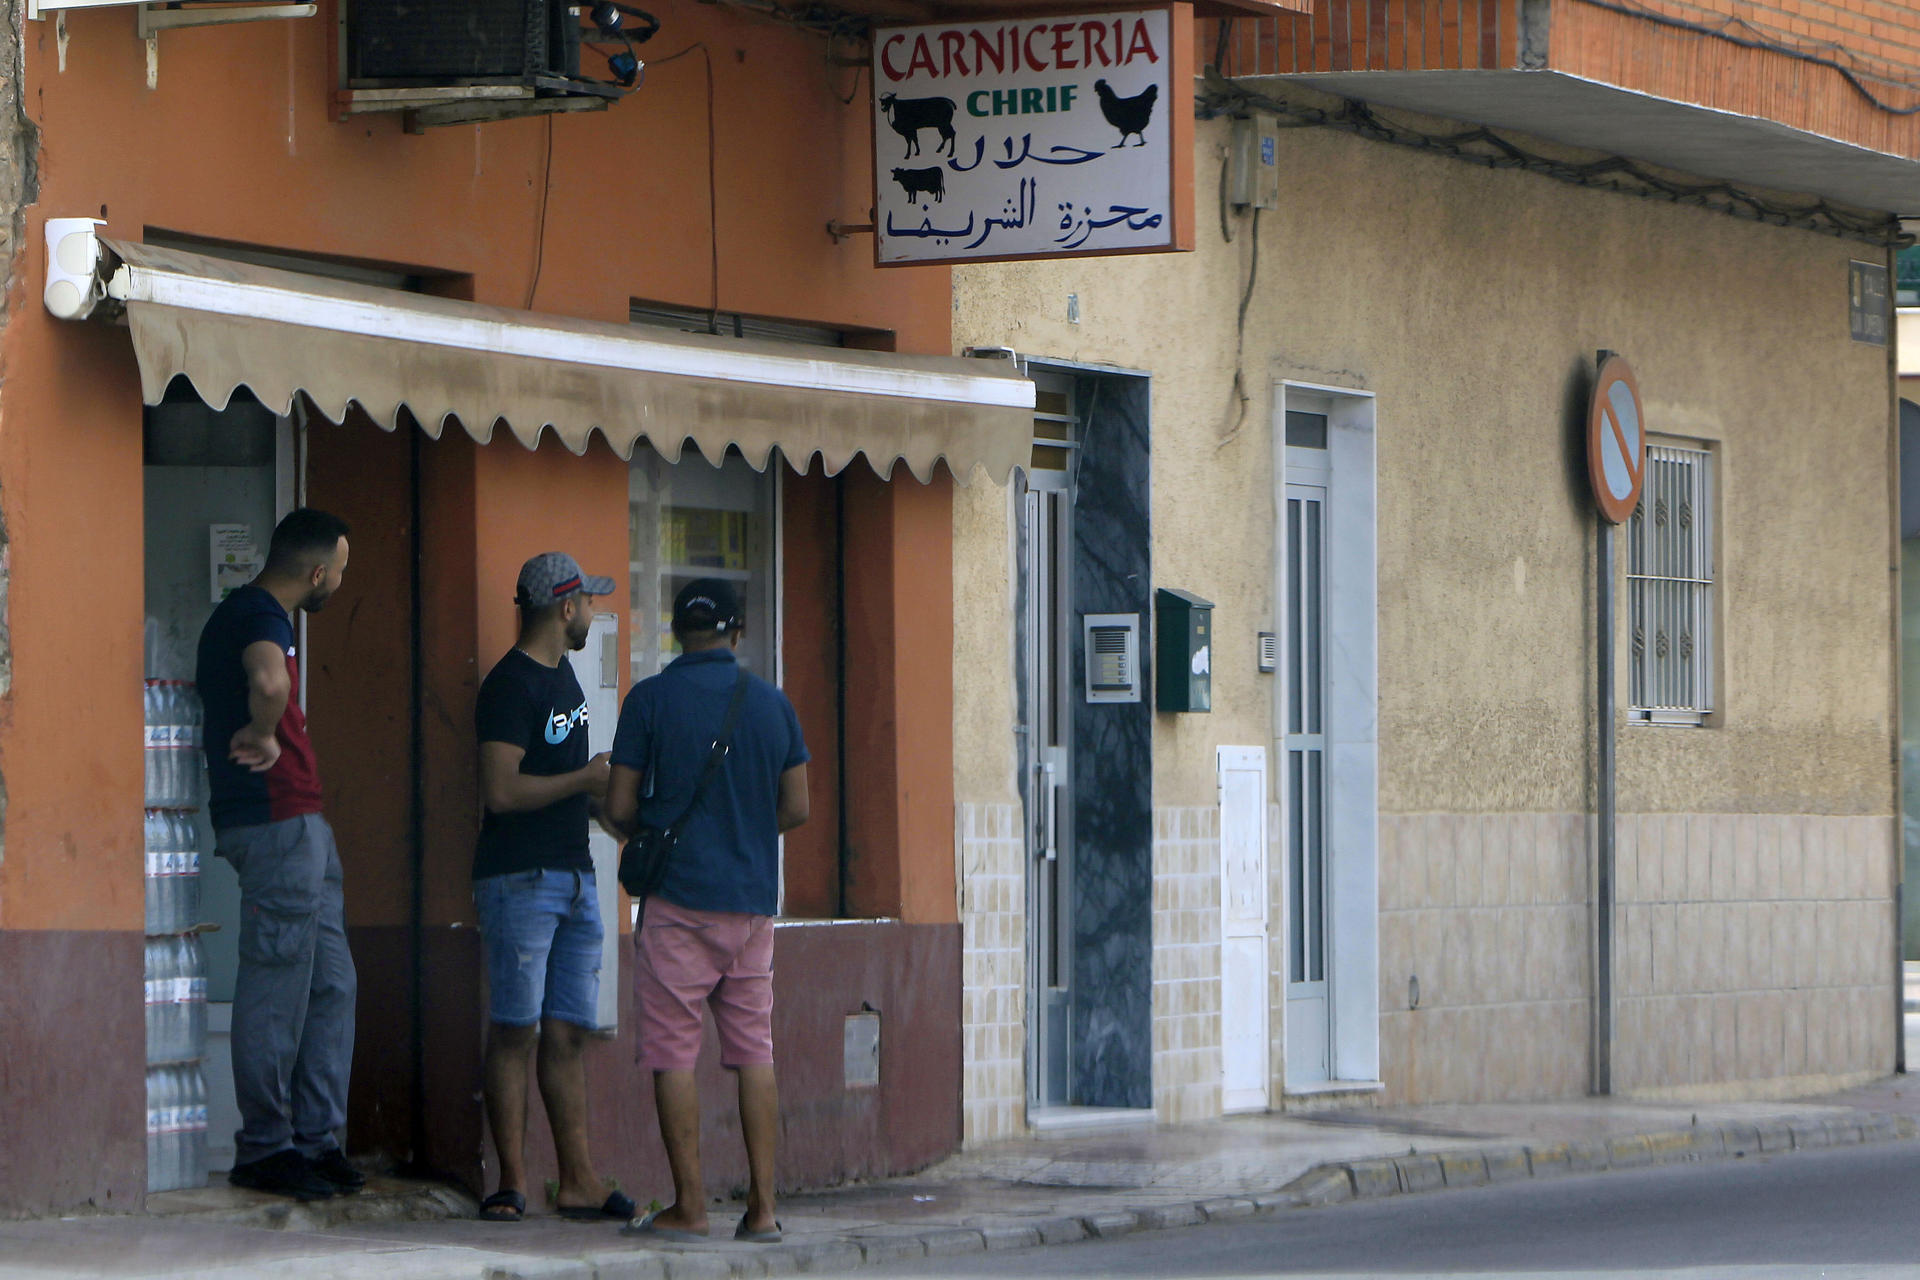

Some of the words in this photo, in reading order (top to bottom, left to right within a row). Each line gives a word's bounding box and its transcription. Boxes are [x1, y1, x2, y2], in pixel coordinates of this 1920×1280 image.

[881, 18, 1159, 81] CARNICERIA
[967, 85, 1078, 117] CHRIF
[947, 133, 1105, 171] حلال
[887, 177, 1036, 249] الشريف
